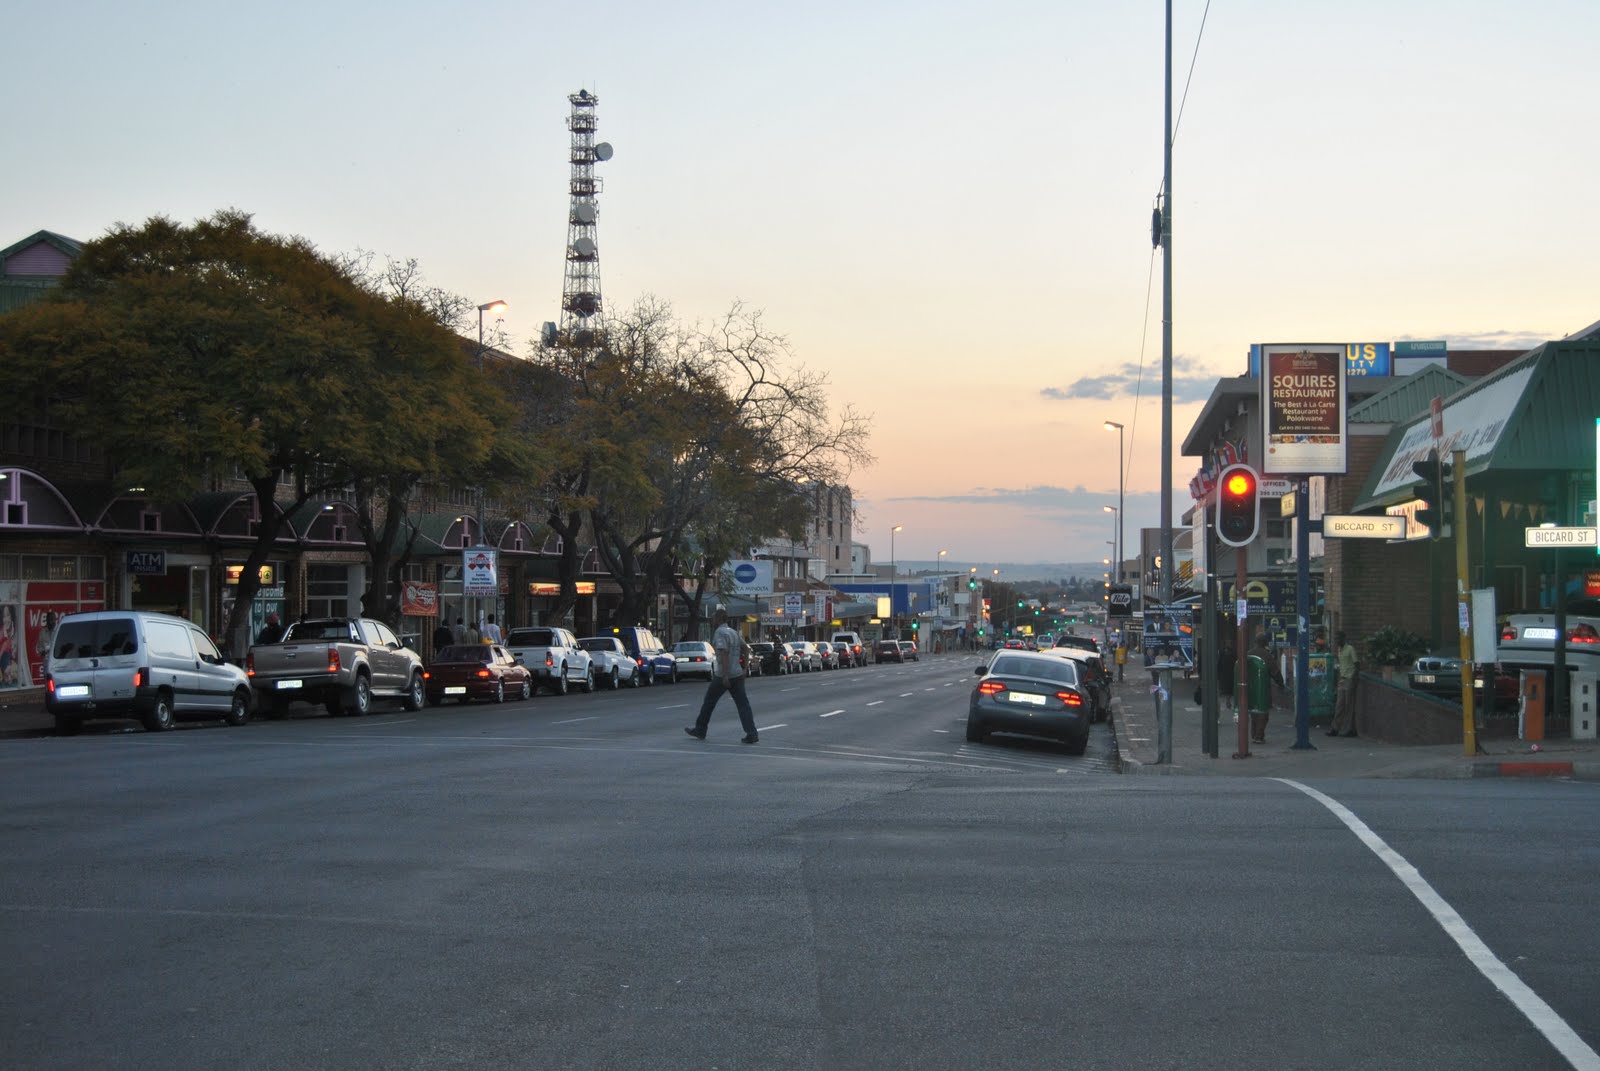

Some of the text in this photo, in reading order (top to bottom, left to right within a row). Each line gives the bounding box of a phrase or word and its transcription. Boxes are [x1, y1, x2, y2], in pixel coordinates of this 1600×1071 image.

[1347, 344, 1376, 360] US
[1273, 375, 1336, 389] SQUIRES
[1273, 389, 1336, 398] RESTAURANT
[1334, 522, 1394, 532] BICCARD ST
[1535, 531, 1588, 543] BICCARD ST
[130, 551, 161, 566] ATM
[256, 587, 284, 597] elcome
